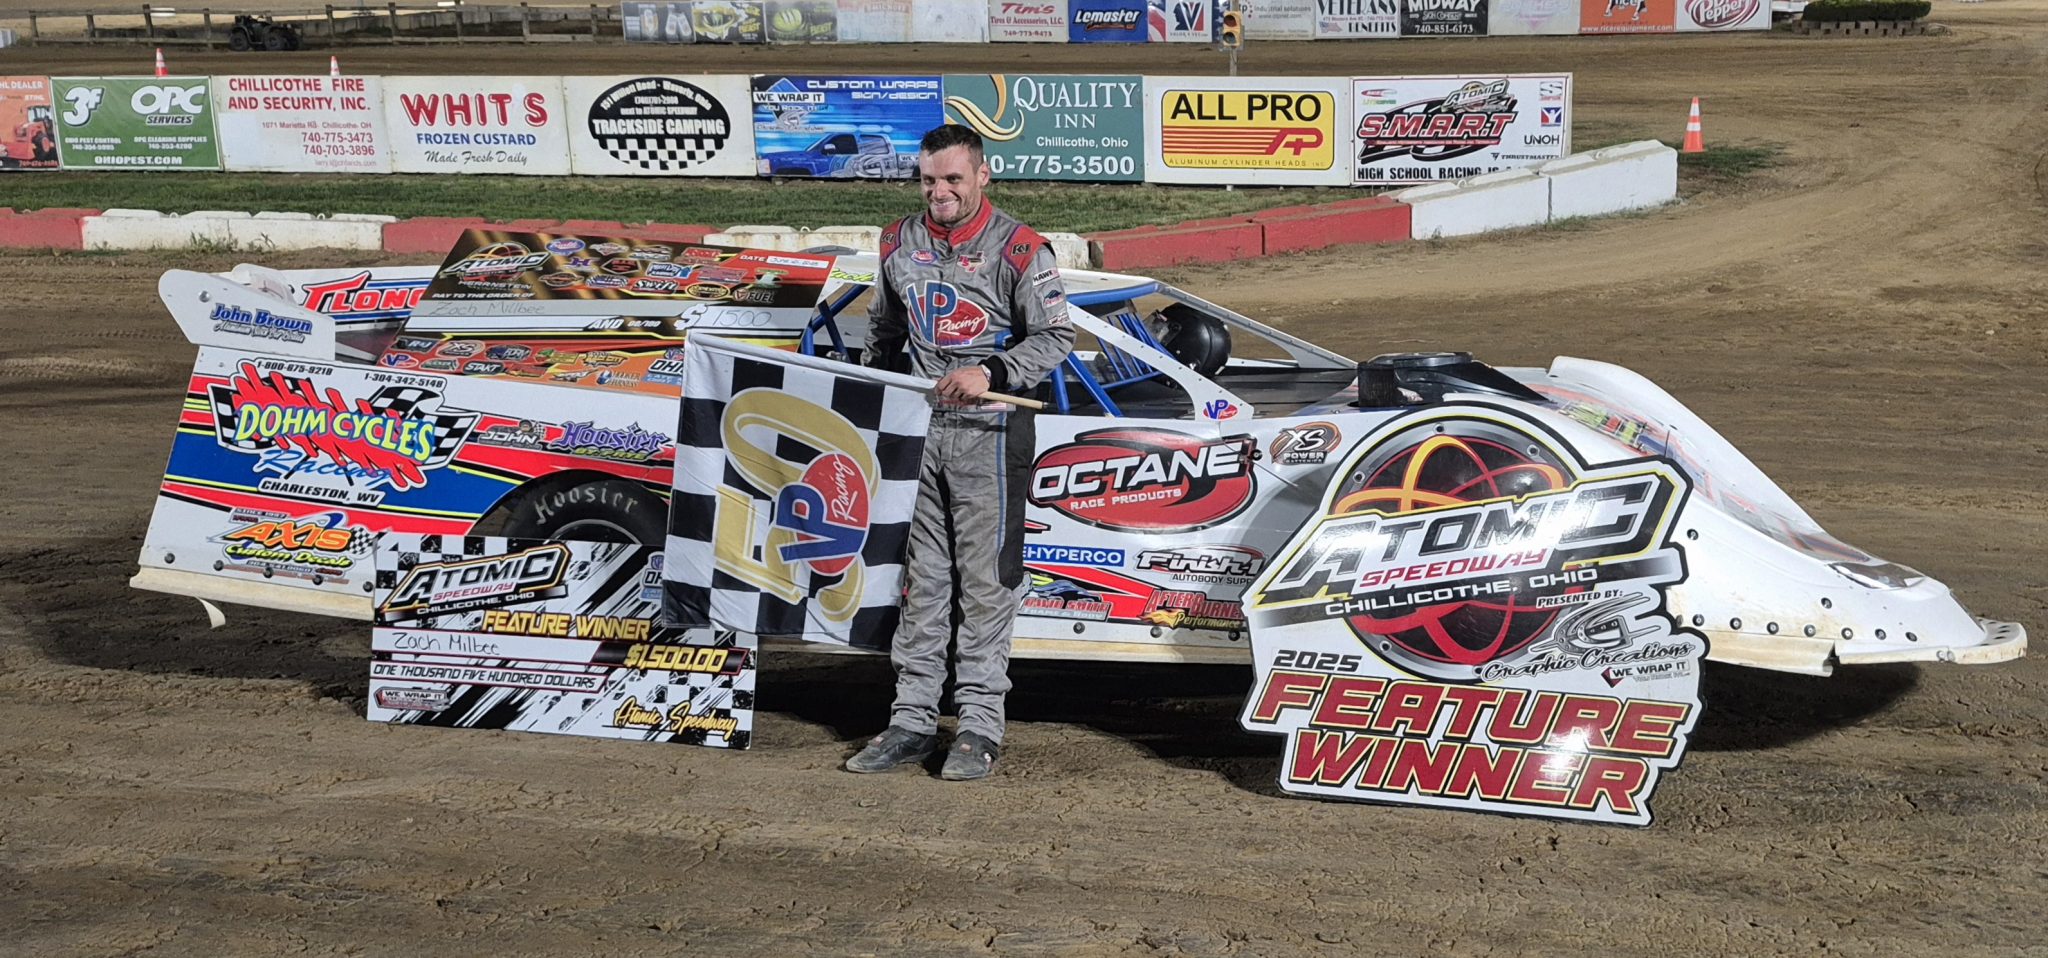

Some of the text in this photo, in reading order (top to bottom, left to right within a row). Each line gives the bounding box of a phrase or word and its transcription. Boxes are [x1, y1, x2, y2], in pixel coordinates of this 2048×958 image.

[1002, 2, 1055, 14] Tim's
[1075, 9, 1139, 23] Lemaster
[1318, 0, 1397, 15] VETERANS
[1408, 0, 1481, 12] MIDWAY
[1699, 0, 1743, 23] Pepper
[1349, 21, 1396, 32] BENEFITS
[1415, 25, 1474, 33] 740-851-6173
[11, 81, 43, 89] DEALER
[229, 78, 365, 92] CHILLICOTHE FIRE
[807, 80, 938, 89] CUSTOM WRAPS
[1013, 76, 1138, 112] QUALITY
[1445, 82, 1507, 106] ATOMIC
[131, 85, 206, 115] OPC
[228, 97, 371, 112] AND SECURITY, INC.
[756, 93, 774, 101] WE
[777, 93, 810, 101] WRAP
[1170, 94, 1321, 121] ALL PRO
[147, 115, 193, 124] SERVICES
[592, 119, 725, 135] TRACKSIDE CAMPING
[1055, 114, 1096, 128] INN
[301, 132, 373, 143] 740-775-3473
[417, 133, 537, 145] FROZEN CUSTARD
[1036, 136, 1129, 148] Chillicothe, Ohio
[1524, 134, 1560, 145] UNOH
[303, 145, 375, 155] 740-703-3896
[425, 151, 528, 166] Made Fresh Daily
[94, 156, 182, 165] OHIOPEST.COM
[984, 155, 1135, 175] 0-775-3500
[1222, 158, 1271, 166] CYLINDER
[1357, 168, 1384, 179] HIGH
[1389, 168, 1433, 179] SCHOOL
[440, 252, 549, 273] ATOMIC
[210, 303, 313, 335] John Brown
[715, 308, 773, 327] 1500
[906, 279, 959, 346] VP
[589, 319, 625, 330] AND
[937, 314, 989, 336] Racing
[256, 360, 333, 376] 1-800-675-9218
[387, 353, 410, 367] VP
[650, 360, 684, 373] OHI
[364, 373, 444, 388] 1-304-342-5148
[1205, 399, 1229, 420] VP
[233, 403, 435, 463] DOHM CYCLES
[484, 430, 539, 445] JOHN
[550, 420, 671, 451] Hoosier
[1281, 428, 1325, 452] XS
[1283, 451, 1325, 459] POWER
[259, 450, 393, 487] Racing
[1031, 440, 1244, 499] OCTANE
[260, 481, 380, 503] CHARLESTON, WV
[831, 453, 856, 523] Racing
[535, 482, 639, 525] Hoosier
[1070, 488, 1182, 511] RACE PRODUCTS
[776, 482, 868, 564] VP
[224, 520, 353, 551] AXIS
[1280, 480, 1660, 588] ATOMIC
[226, 544, 293, 562] Custom
[293, 551, 354, 568] Decals
[396, 549, 563, 606] ATOMIC
[1359, 547, 1548, 588] SPEEDWAY
[1172, 573, 1225, 584] AUTOBODY
[432, 581, 515, 601] SPEEDWAY
[1325, 567, 1598, 616] CHILLICOTHE, OHIO
[1536, 589, 1624, 609] PRESENTED BY:
[416, 592, 535, 615] CHILLICOTHE, OHIO
[483, 610, 651, 640] FEATURE WINNER
[1174, 612, 1240, 628] Performance
[392, 632, 441, 651] Zach
[624, 642, 729, 673] $1,500.00
[1272, 649, 1363, 672] 2025
[1482, 641, 1695, 682] Graphic Creations
[373, 664, 596, 689] ONE THOUSAND FIVE HUNDRED DOLLARS
[1613, 661, 1687, 678] WE WRAP IT
[612, 694, 737, 742] Atomic Speedway
[1250, 670, 1691, 758] FEATURE
[1288, 729, 1651, 816] WINNER
